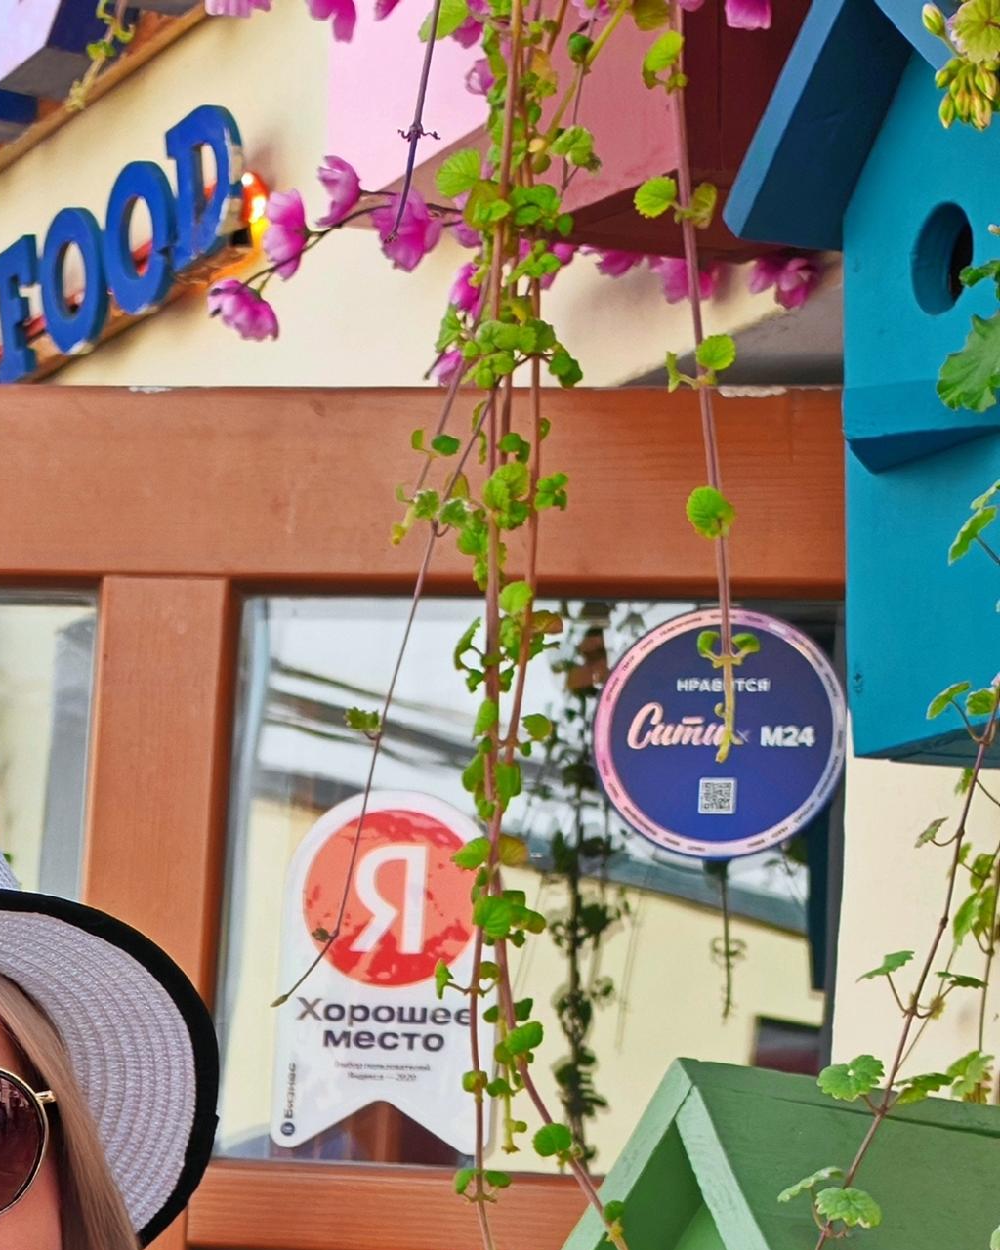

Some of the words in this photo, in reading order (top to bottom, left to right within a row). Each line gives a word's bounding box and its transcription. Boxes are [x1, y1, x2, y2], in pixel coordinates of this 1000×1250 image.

[677, 677, 771, 692] НРАВТСЯ
[760, 725, 816, 747] М24
[322, 1028, 445, 1052] место
